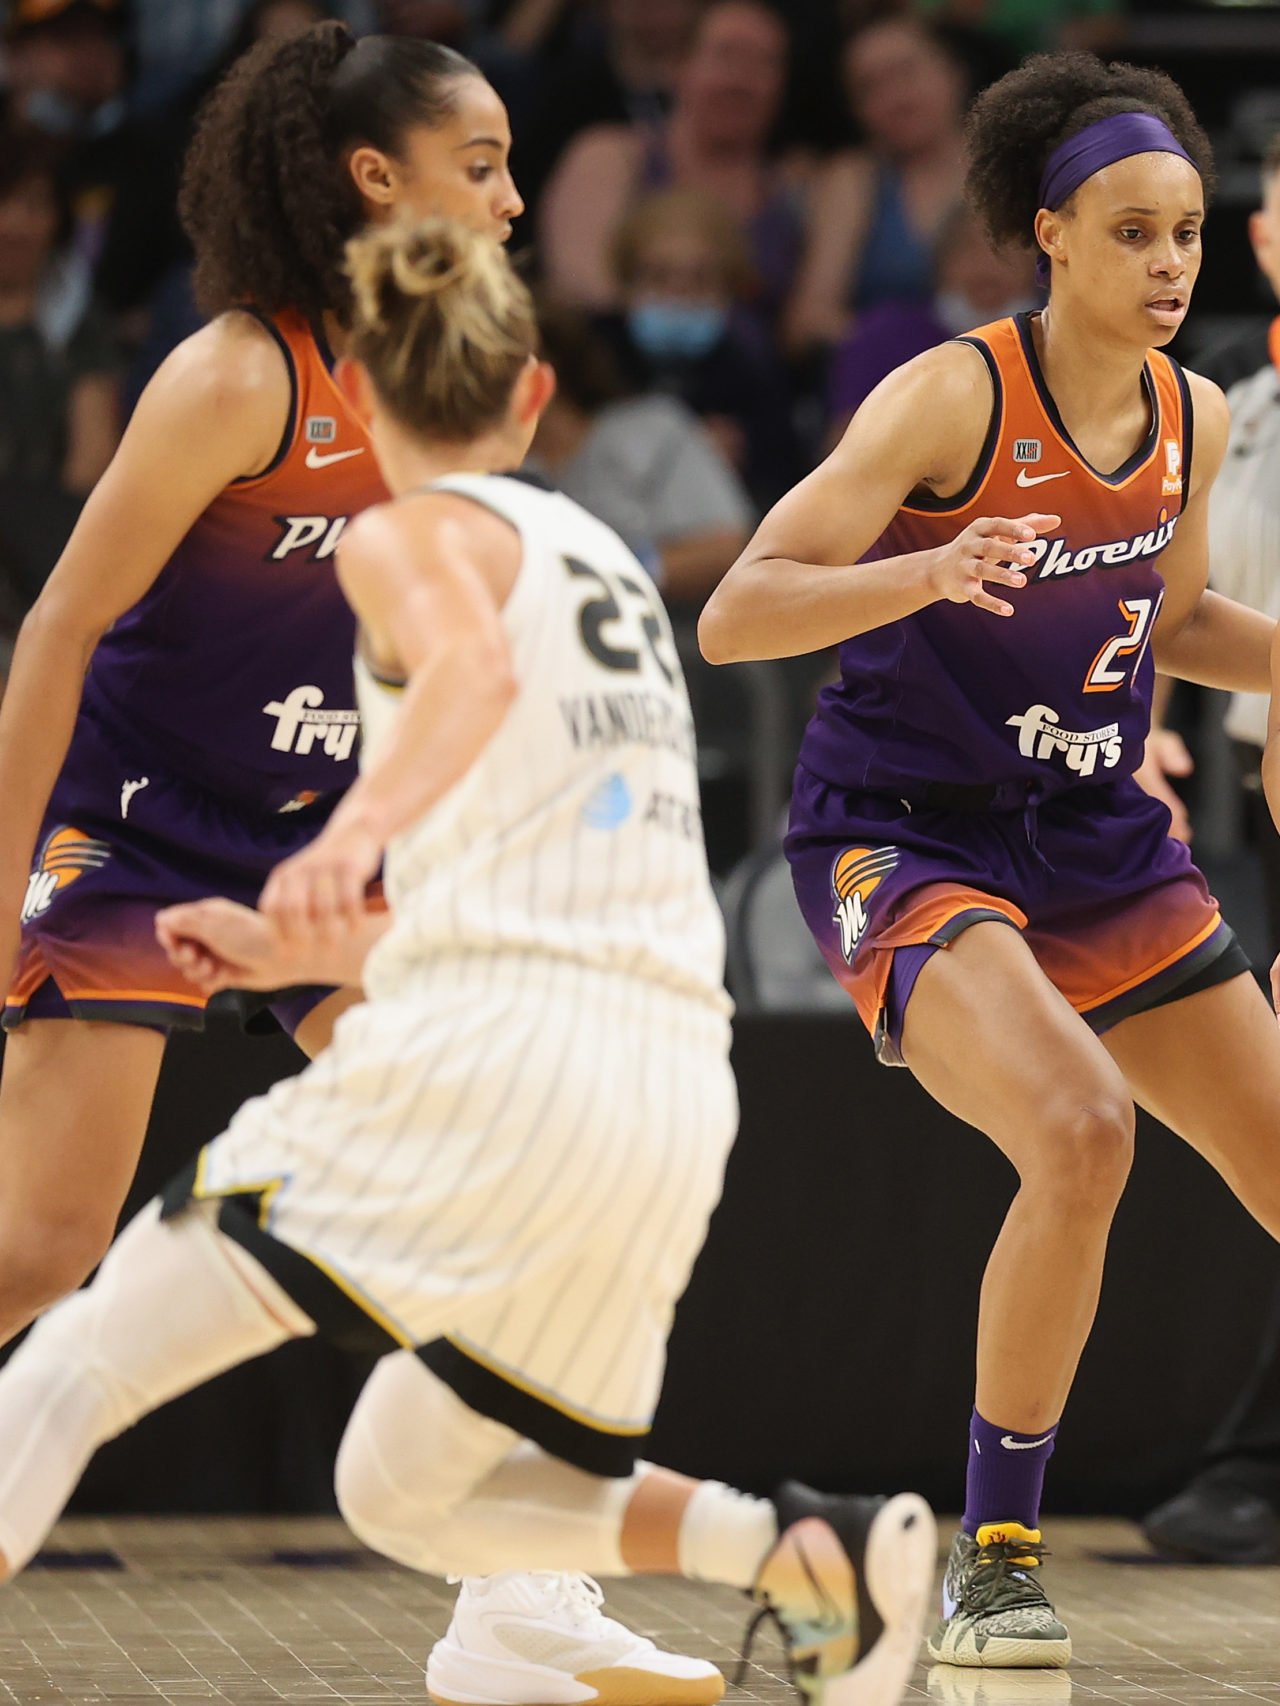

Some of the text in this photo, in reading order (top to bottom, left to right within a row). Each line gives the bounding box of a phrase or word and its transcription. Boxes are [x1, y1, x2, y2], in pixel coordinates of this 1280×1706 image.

[561, 553, 676, 686] 22
[1005, 704, 1123, 777] fry's
[1042, 723, 1116, 743] FOOD STORES
